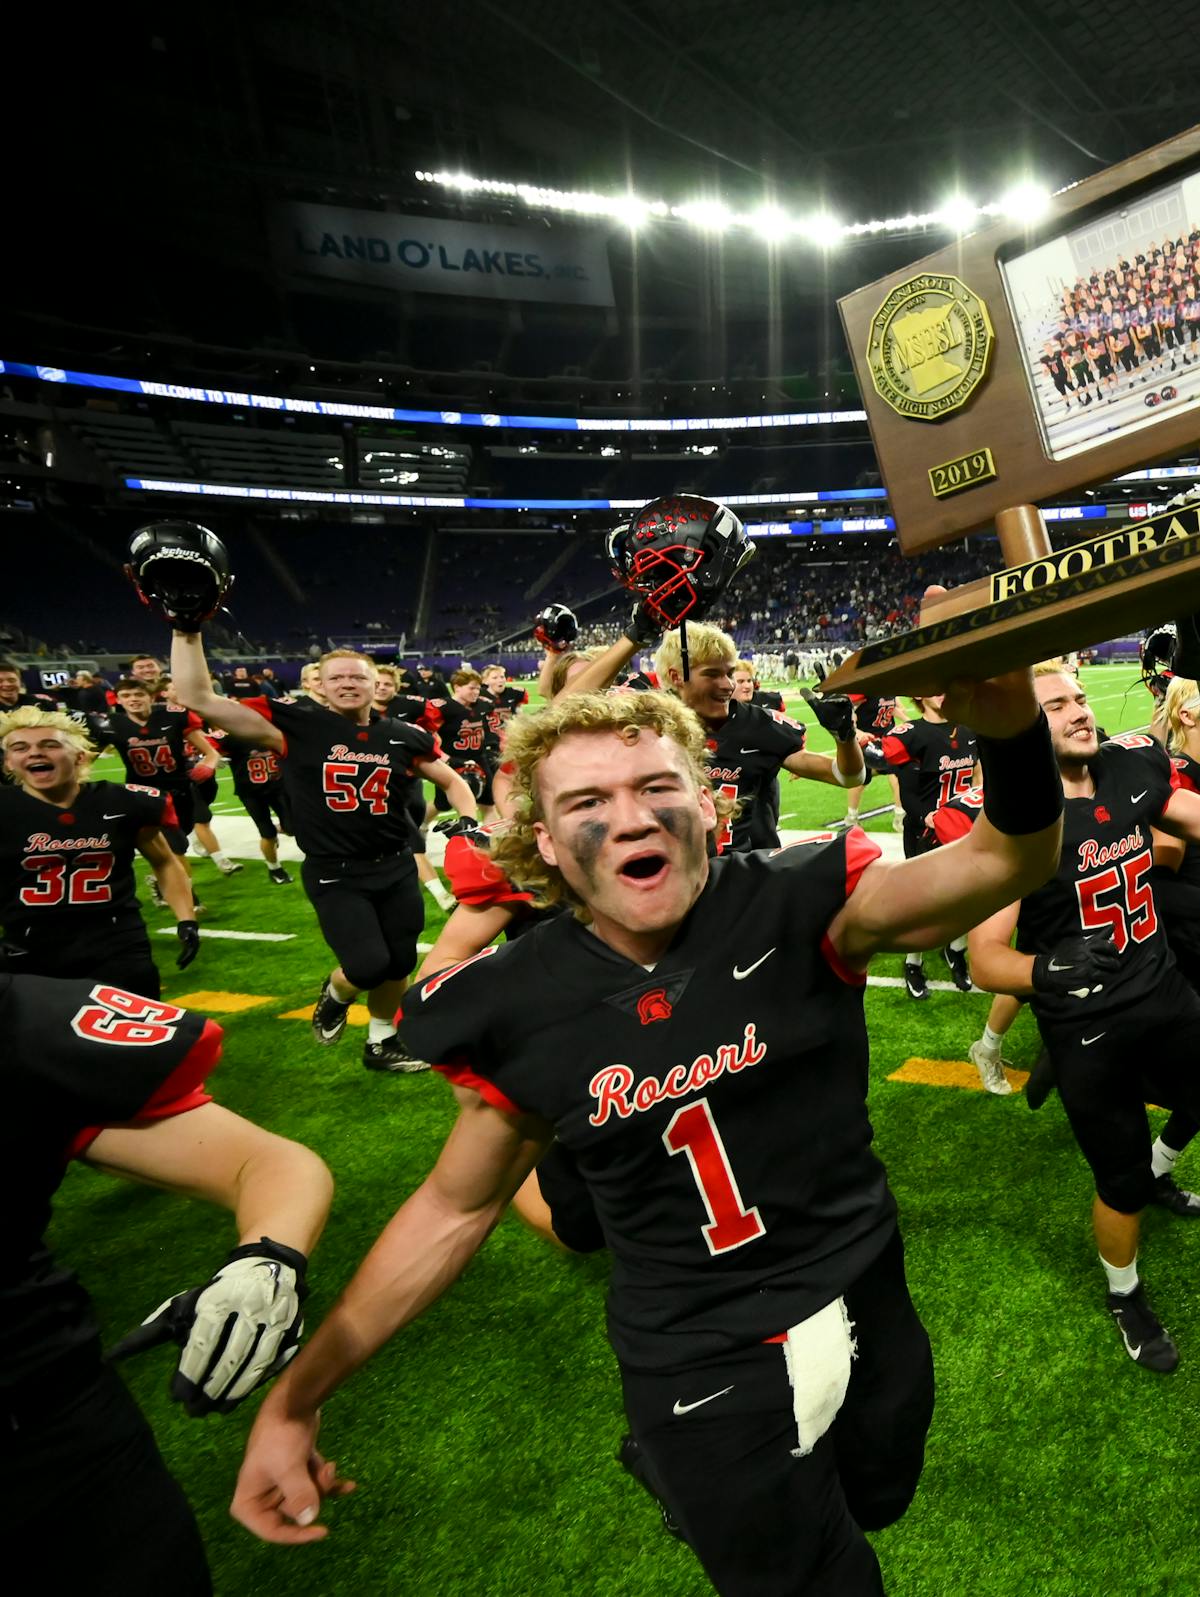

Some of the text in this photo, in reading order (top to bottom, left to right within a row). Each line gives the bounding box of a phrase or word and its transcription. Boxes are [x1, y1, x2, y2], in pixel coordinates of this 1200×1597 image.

[296, 229, 390, 263] LAND
[876, 277, 953, 331] MINNESOTA
[139, 381, 395, 420] WELCOME TO THE PREP BOWL TOURNAMENT
[899, 400, 927, 414] HIGH
[931, 378, 977, 412] SCHOOL
[935, 455, 985, 490] 2019
[880, 616, 960, 659] STATE
[968, 584, 1060, 628] CLASS
[1065, 557, 1151, 597] AAAA
[128, 745, 177, 777] 84
[327, 744, 390, 765] Rocori
[703, 766, 742, 781] cori
[323, 762, 392, 815] 54
[24, 832, 112, 852] Rocori
[1078, 825, 1144, 871] Rocori
[20, 851, 116, 906] 32
[1075, 849, 1158, 954] 55
[70, 984, 187, 1046] 69
[588, 1022, 768, 1127] Rocori
[661, 1096, 767, 1257] 1
